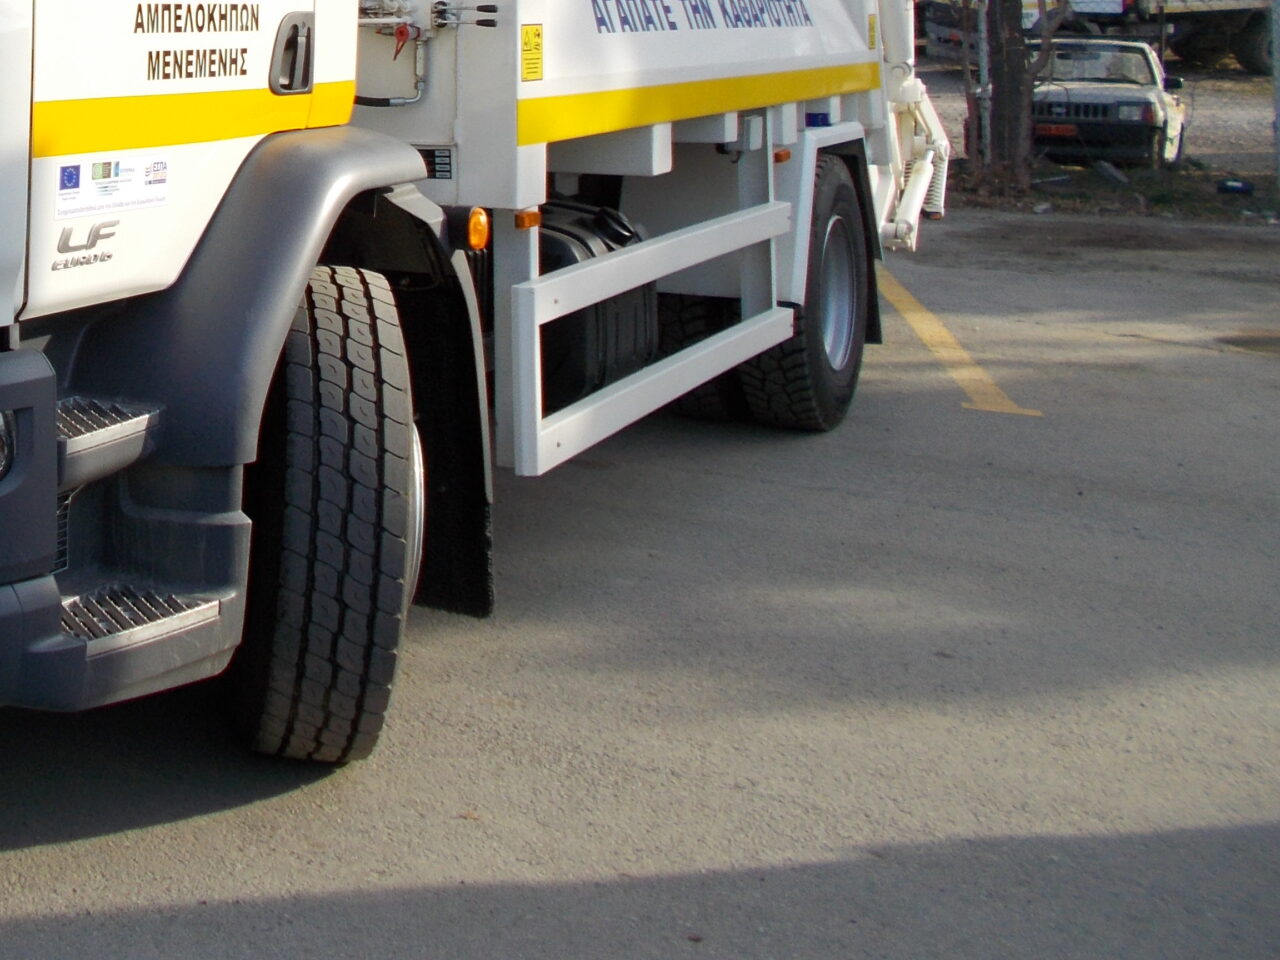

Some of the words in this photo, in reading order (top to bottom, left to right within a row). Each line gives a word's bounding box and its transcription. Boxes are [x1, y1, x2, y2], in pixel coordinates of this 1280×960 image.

[133, 3, 260, 34] ΑΜΠΕΛΟΚΗΠΩΝ
[147, 48, 248, 81] ΜΕΝΕΜΕΝΗΣ
[57, 219, 120, 254] LF
